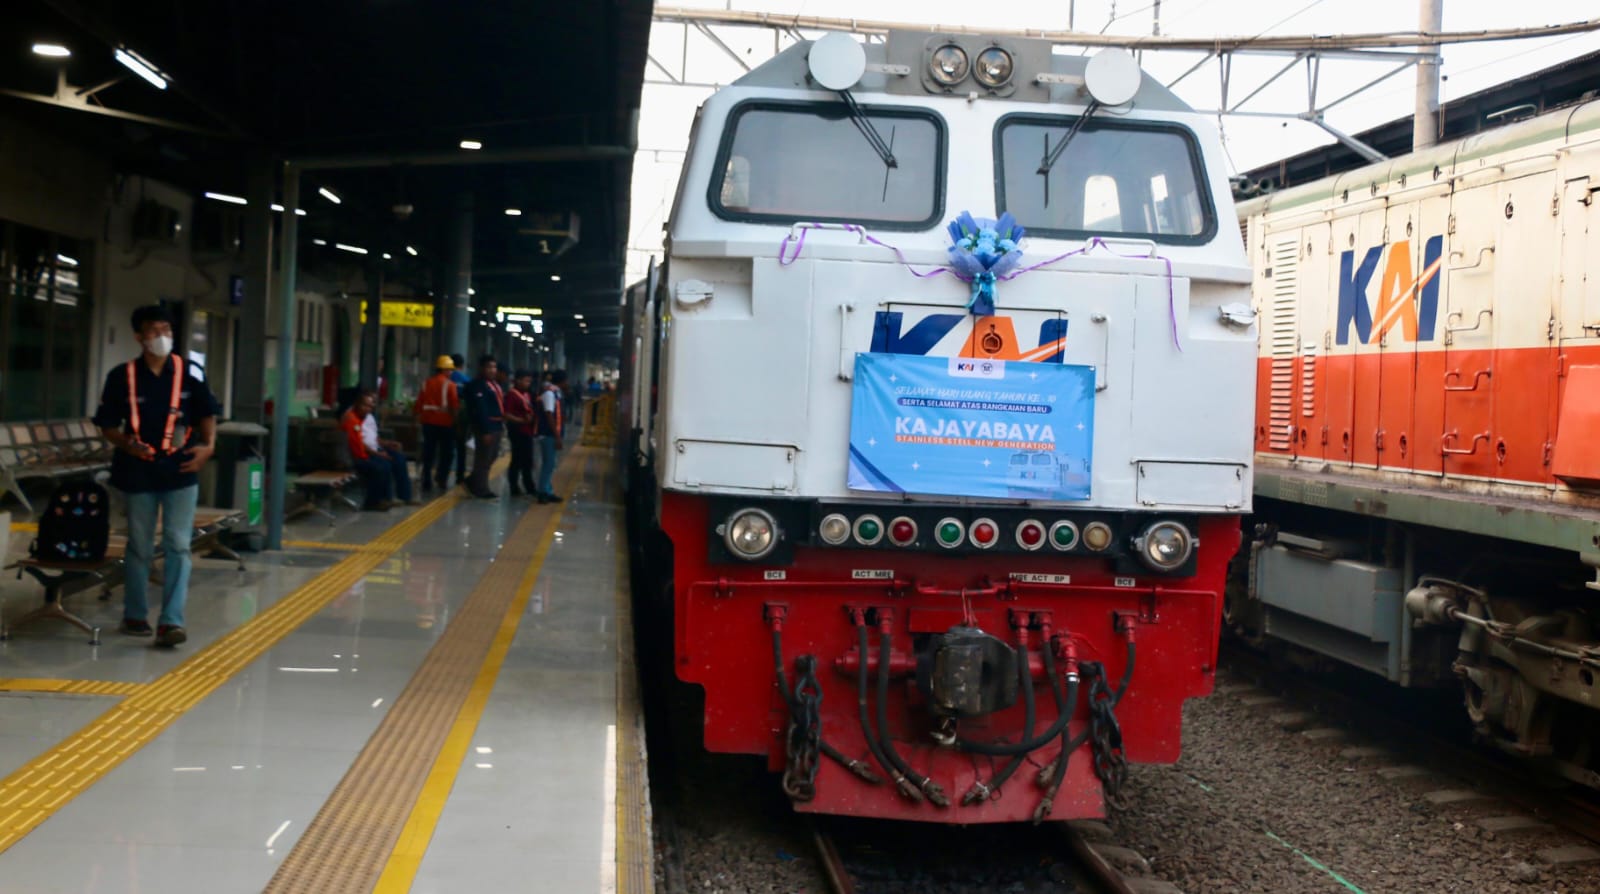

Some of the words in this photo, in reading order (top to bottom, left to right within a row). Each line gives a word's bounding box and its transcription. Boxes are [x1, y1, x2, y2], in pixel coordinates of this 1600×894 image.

[1336, 234, 1443, 345] KAI
[957, 362, 975, 372] KAI
[895, 385, 936, 396] SELAMAT
[902, 398, 925, 407] SERTA
[926, 399, 960, 409] SELAMAT
[961, 401, 981, 410] ATAS
[982, 403, 1026, 411] RANGKAIAN
[1026, 405, 1048, 413] BARU
[895, 416, 928, 435] KA
[931, 418, 1056, 442] JAYABAYA
[895, 435, 944, 444] STAINLESS
[975, 439, 994, 448] NEW
[997, 440, 1055, 450] GENERATION
